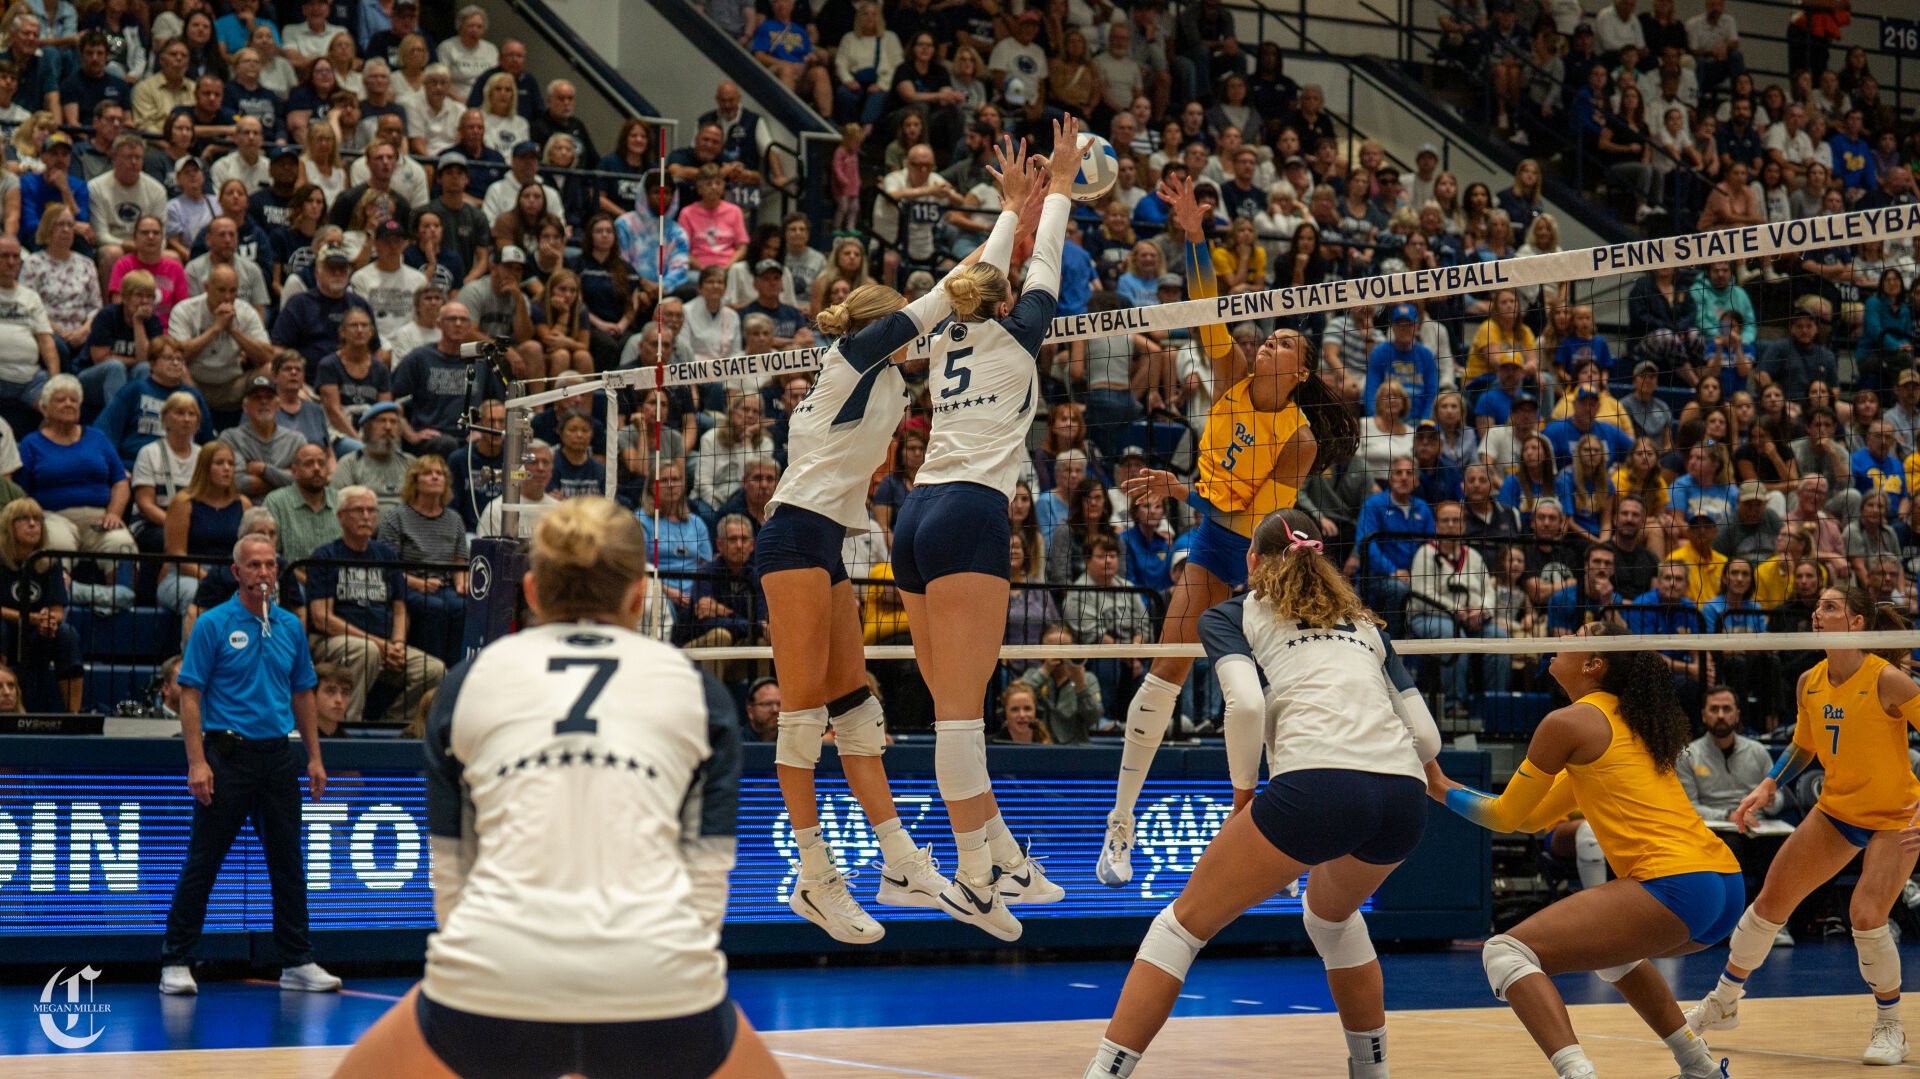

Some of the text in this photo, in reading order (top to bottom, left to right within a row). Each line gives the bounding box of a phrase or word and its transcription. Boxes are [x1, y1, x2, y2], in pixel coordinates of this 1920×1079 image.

[1884, 26, 1918, 50] 216
[733, 187, 760, 206] 114
[913, 204, 940, 222] 115
[1592, 239, 1665, 271] PENN
[1674, 227, 1759, 260] STATE
[1217, 262, 1509, 317] PENN STATE VOLLEYBALL
[669, 361, 708, 381] PENN
[712, 356, 757, 377] STATE
[940, 346, 973, 399] 5
[1235, 422, 1255, 447] Pitt
[1220, 441, 1243, 471] 5
[547, 657, 620, 735] 7
[1823, 704, 1844, 719] Pitt
[1825, 725, 1840, 755] 7
